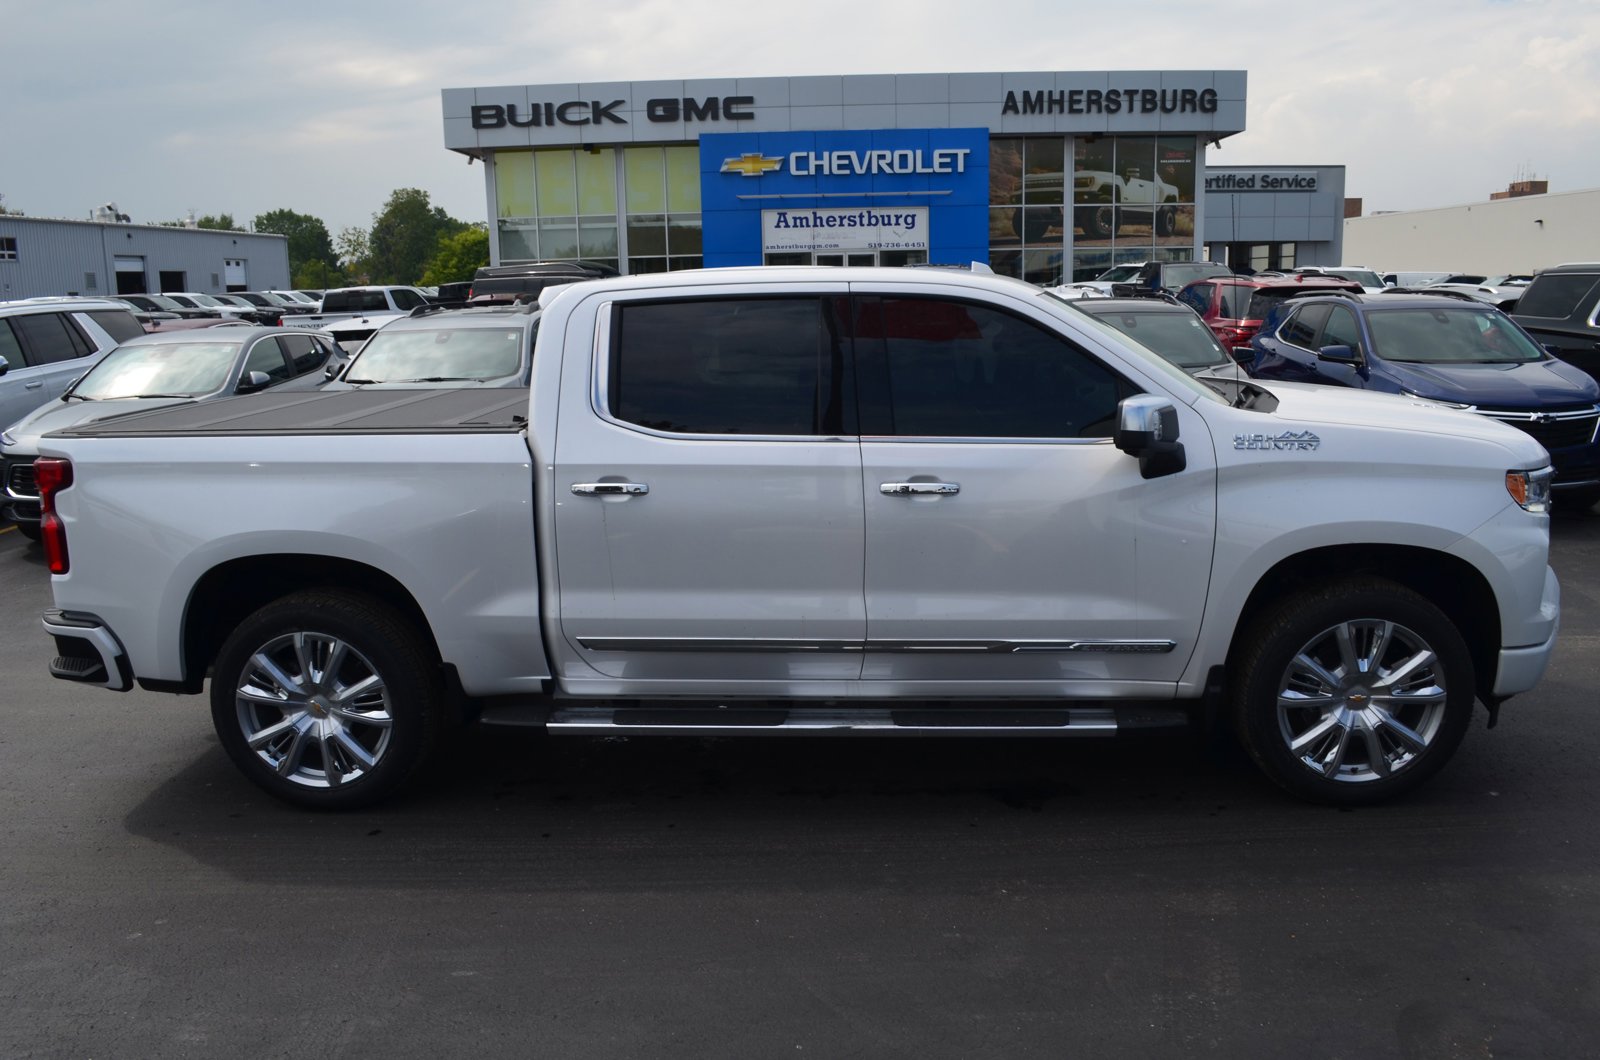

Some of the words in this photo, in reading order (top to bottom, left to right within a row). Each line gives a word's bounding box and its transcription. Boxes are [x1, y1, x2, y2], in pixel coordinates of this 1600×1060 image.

[1001, 88, 1218, 114] AMHERSTBURG
[471, 100, 628, 129] BUICK
[646, 96, 755, 122] GMC
[789, 149, 971, 176] CHEVROLET
[1205, 174, 1256, 189] rtified
[1260, 174, 1316, 189] Service
[774, 210, 917, 230] Amherstburg
[1233, 433, 1276, 442] HIGH
[1233, 441, 1320, 451] COUNTRY
